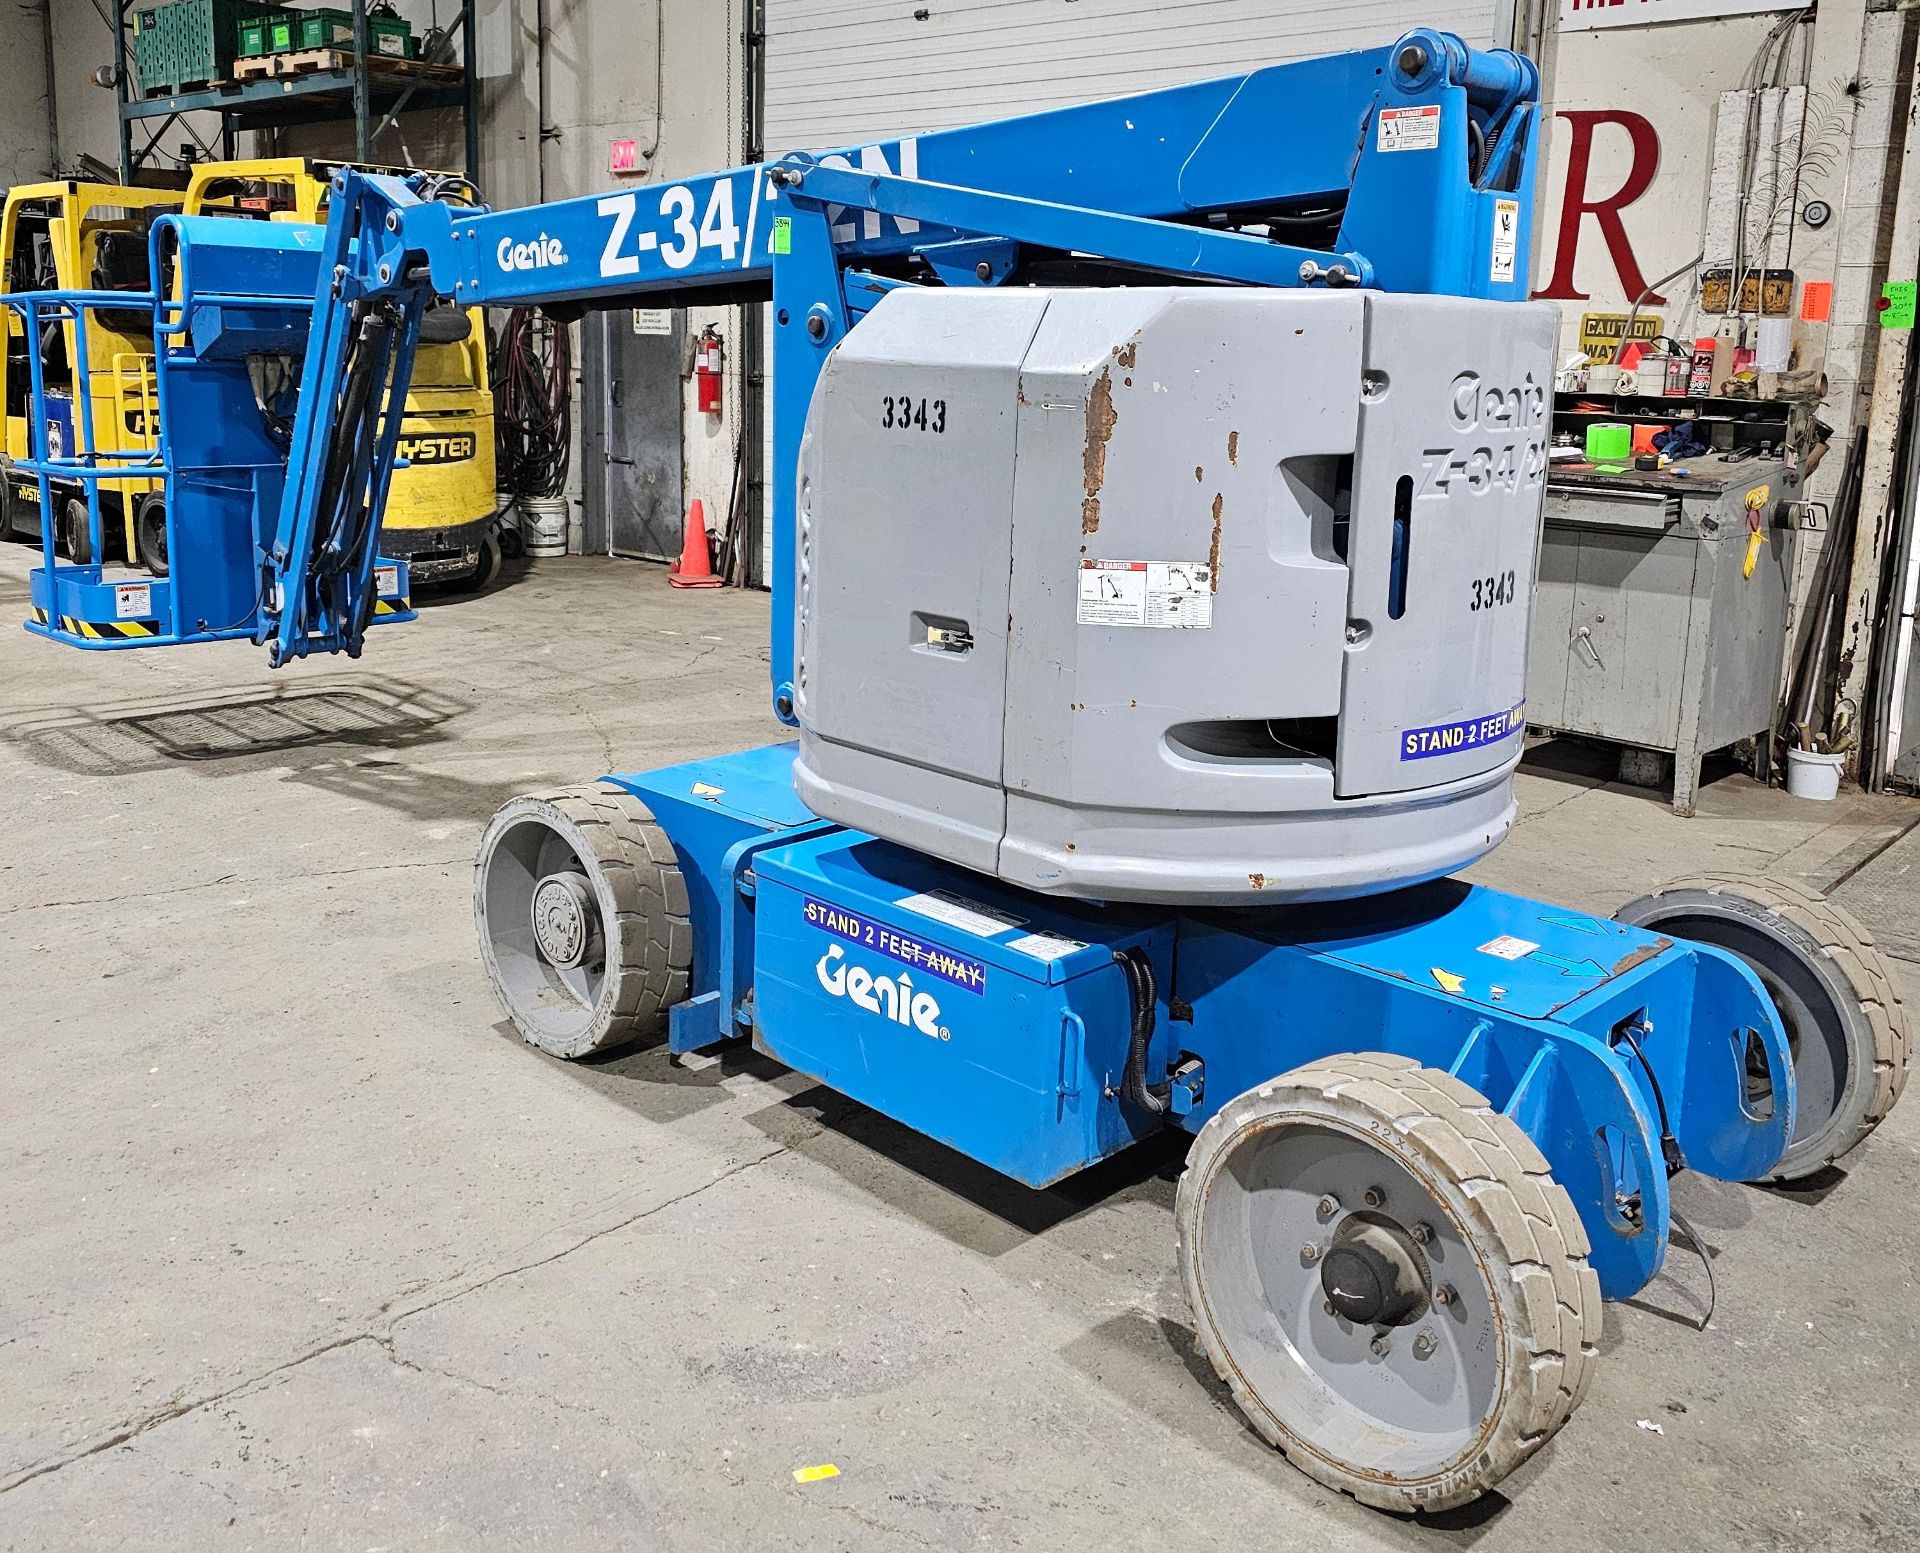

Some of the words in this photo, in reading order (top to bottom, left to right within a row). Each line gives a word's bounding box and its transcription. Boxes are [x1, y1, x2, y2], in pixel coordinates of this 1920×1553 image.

[612, 141, 636, 168] EXIT
[597, 138, 918, 277] Z-34/N
[1530, 110, 1667, 305] R
[882, 396, 946, 434] 3343
[18, 486, 42, 503] HYSTE
[1103, 561, 1132, 570] DANGER
[1470, 569, 1515, 612] 3343
[1406, 727, 1464, 754] STAND
[1467, 724, 1477, 744] 2
[1480, 714, 1508, 741] FEET
[806, 902, 861, 938] STAND
[864, 925, 875, 945] 2
[879, 931, 923, 963] FEET
[926, 950, 981, 987] AWAY
